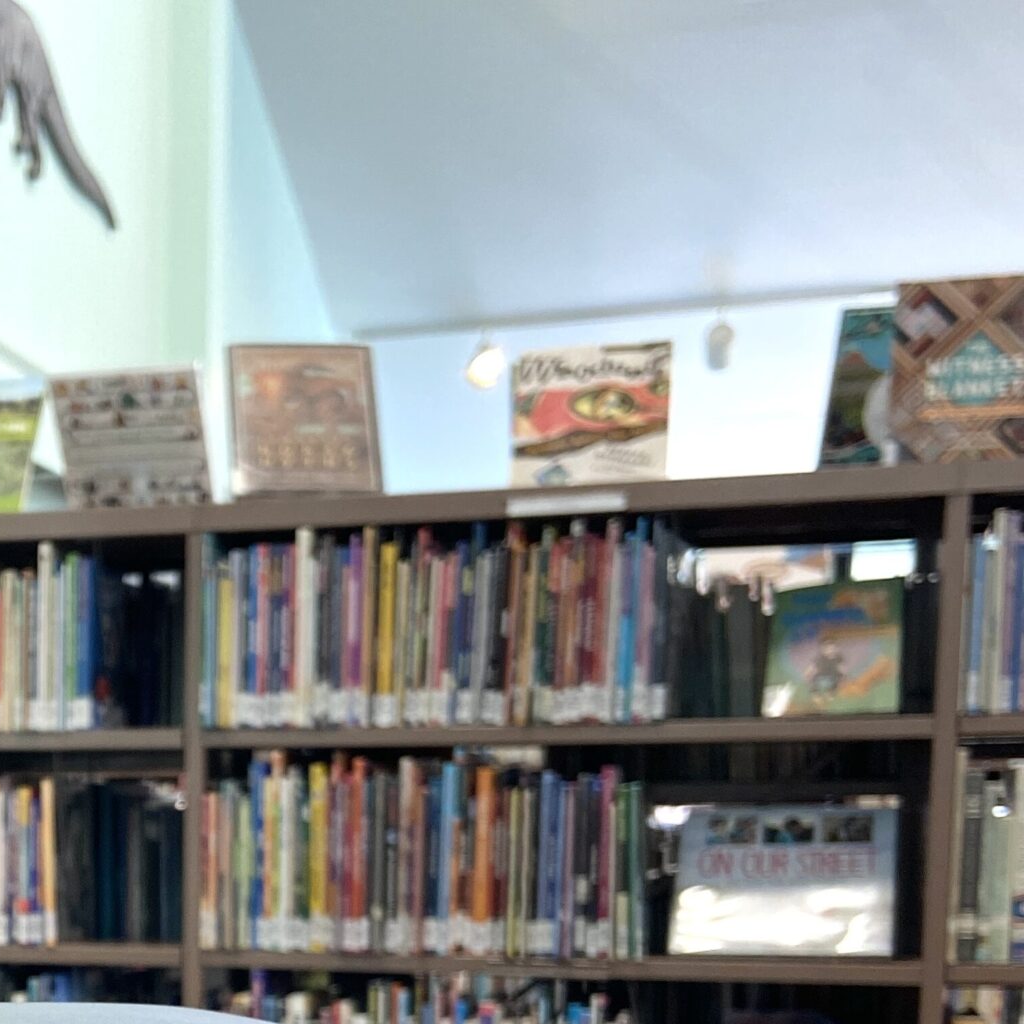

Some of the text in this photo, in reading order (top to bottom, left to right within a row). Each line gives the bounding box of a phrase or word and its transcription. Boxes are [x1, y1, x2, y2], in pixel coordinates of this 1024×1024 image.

[696, 846, 879, 881] ON OUR STREET
